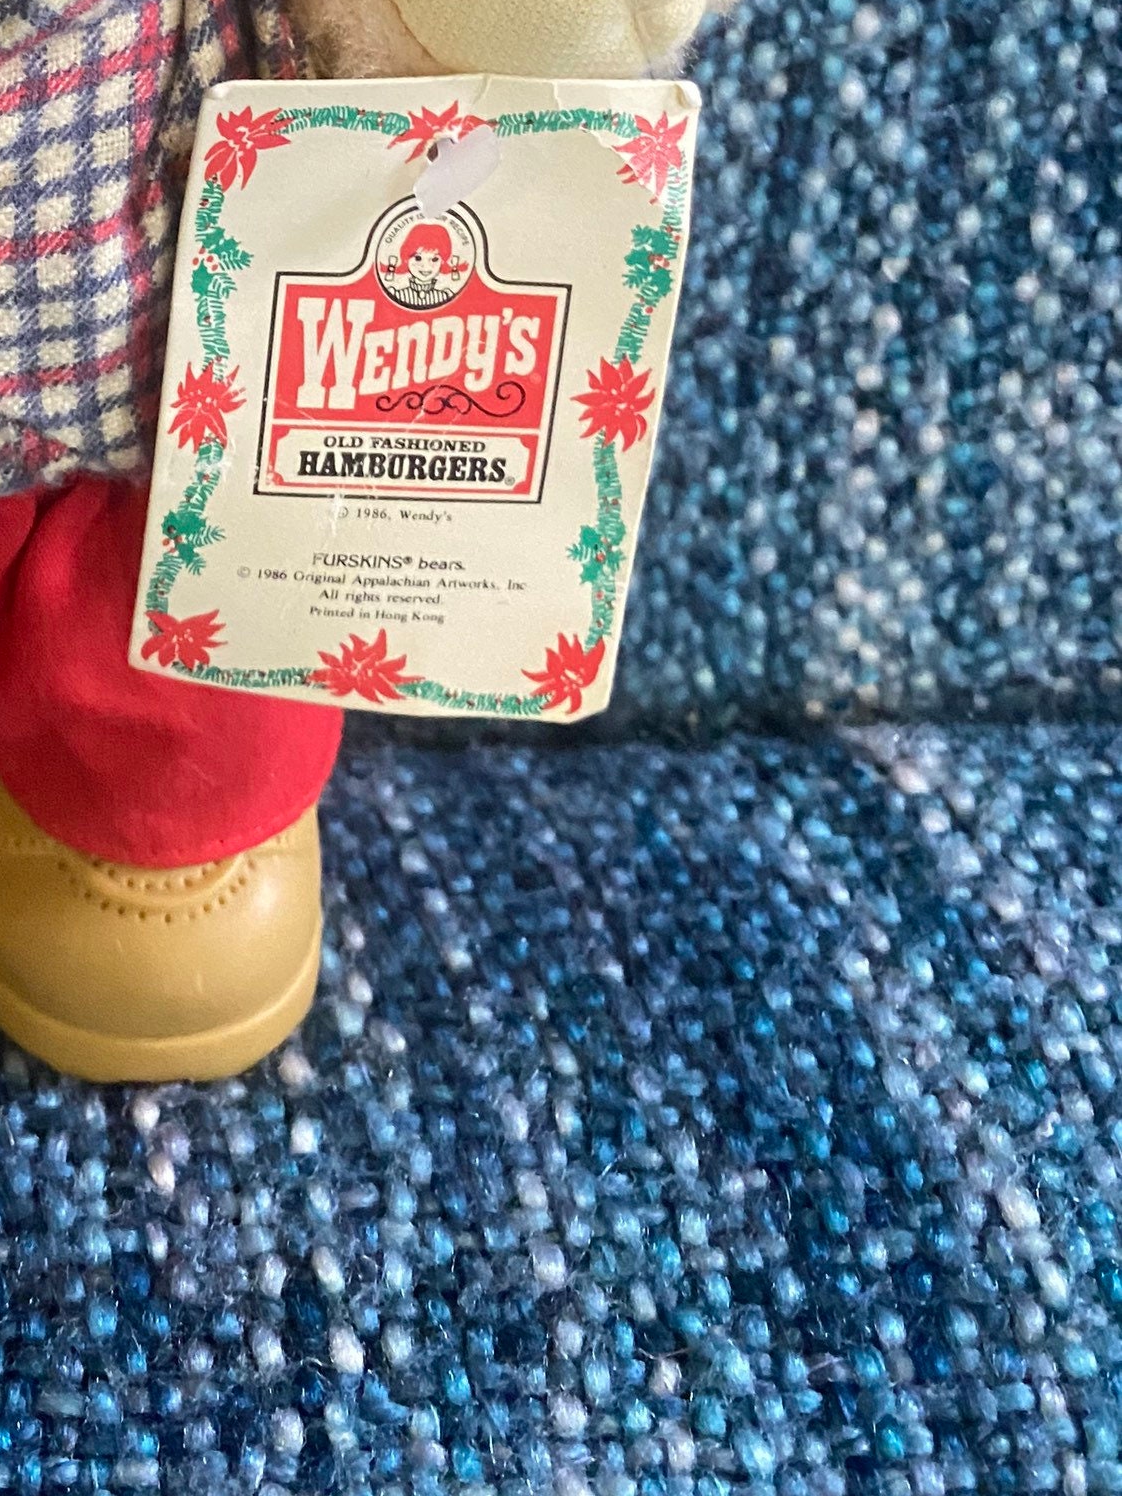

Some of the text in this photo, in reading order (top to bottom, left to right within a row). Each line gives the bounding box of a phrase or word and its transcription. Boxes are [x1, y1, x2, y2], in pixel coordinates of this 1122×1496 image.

[384, 215, 415, 244] QUALITY
[323, 436, 486, 453] OLD FASHIONED
[357, 507, 391, 520] 1986,
[400, 509, 452, 524] Wendy's
[258, 568, 287, 580] 1986
[293, 570, 346, 585] Original
[352, 574, 431, 588] Appalachian
[319, 589, 339, 600] All
[345, 590, 381, 604] rights
[310, 606, 445, 625] Printed in Hong Kong
